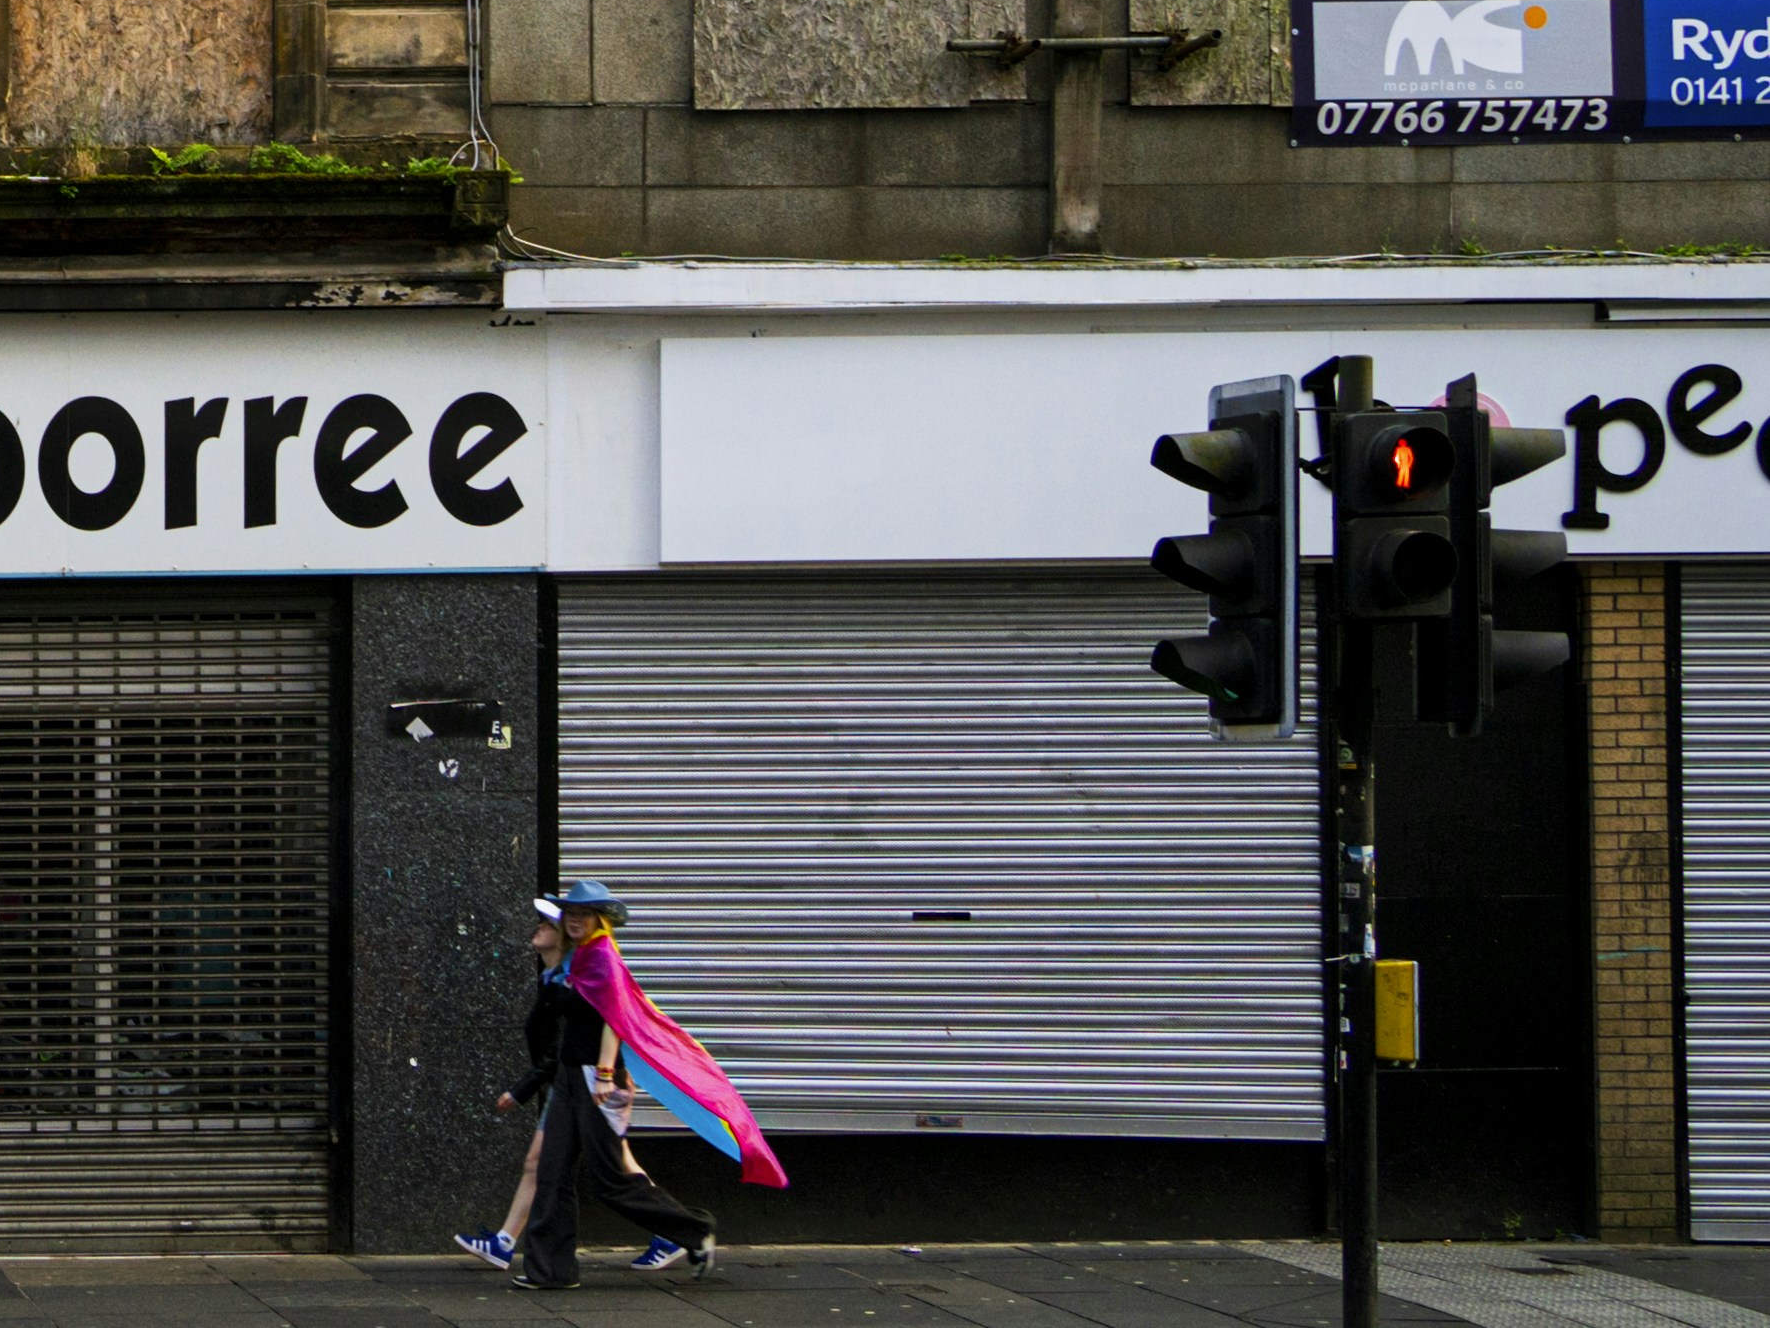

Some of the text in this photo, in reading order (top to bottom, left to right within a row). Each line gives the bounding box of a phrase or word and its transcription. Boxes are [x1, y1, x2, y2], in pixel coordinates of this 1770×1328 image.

[1383, 79, 1524, 93] mcparlane & co
[1670, 76, 1743, 106] 0141
[1316, 99, 1609, 135] 07766 757473
